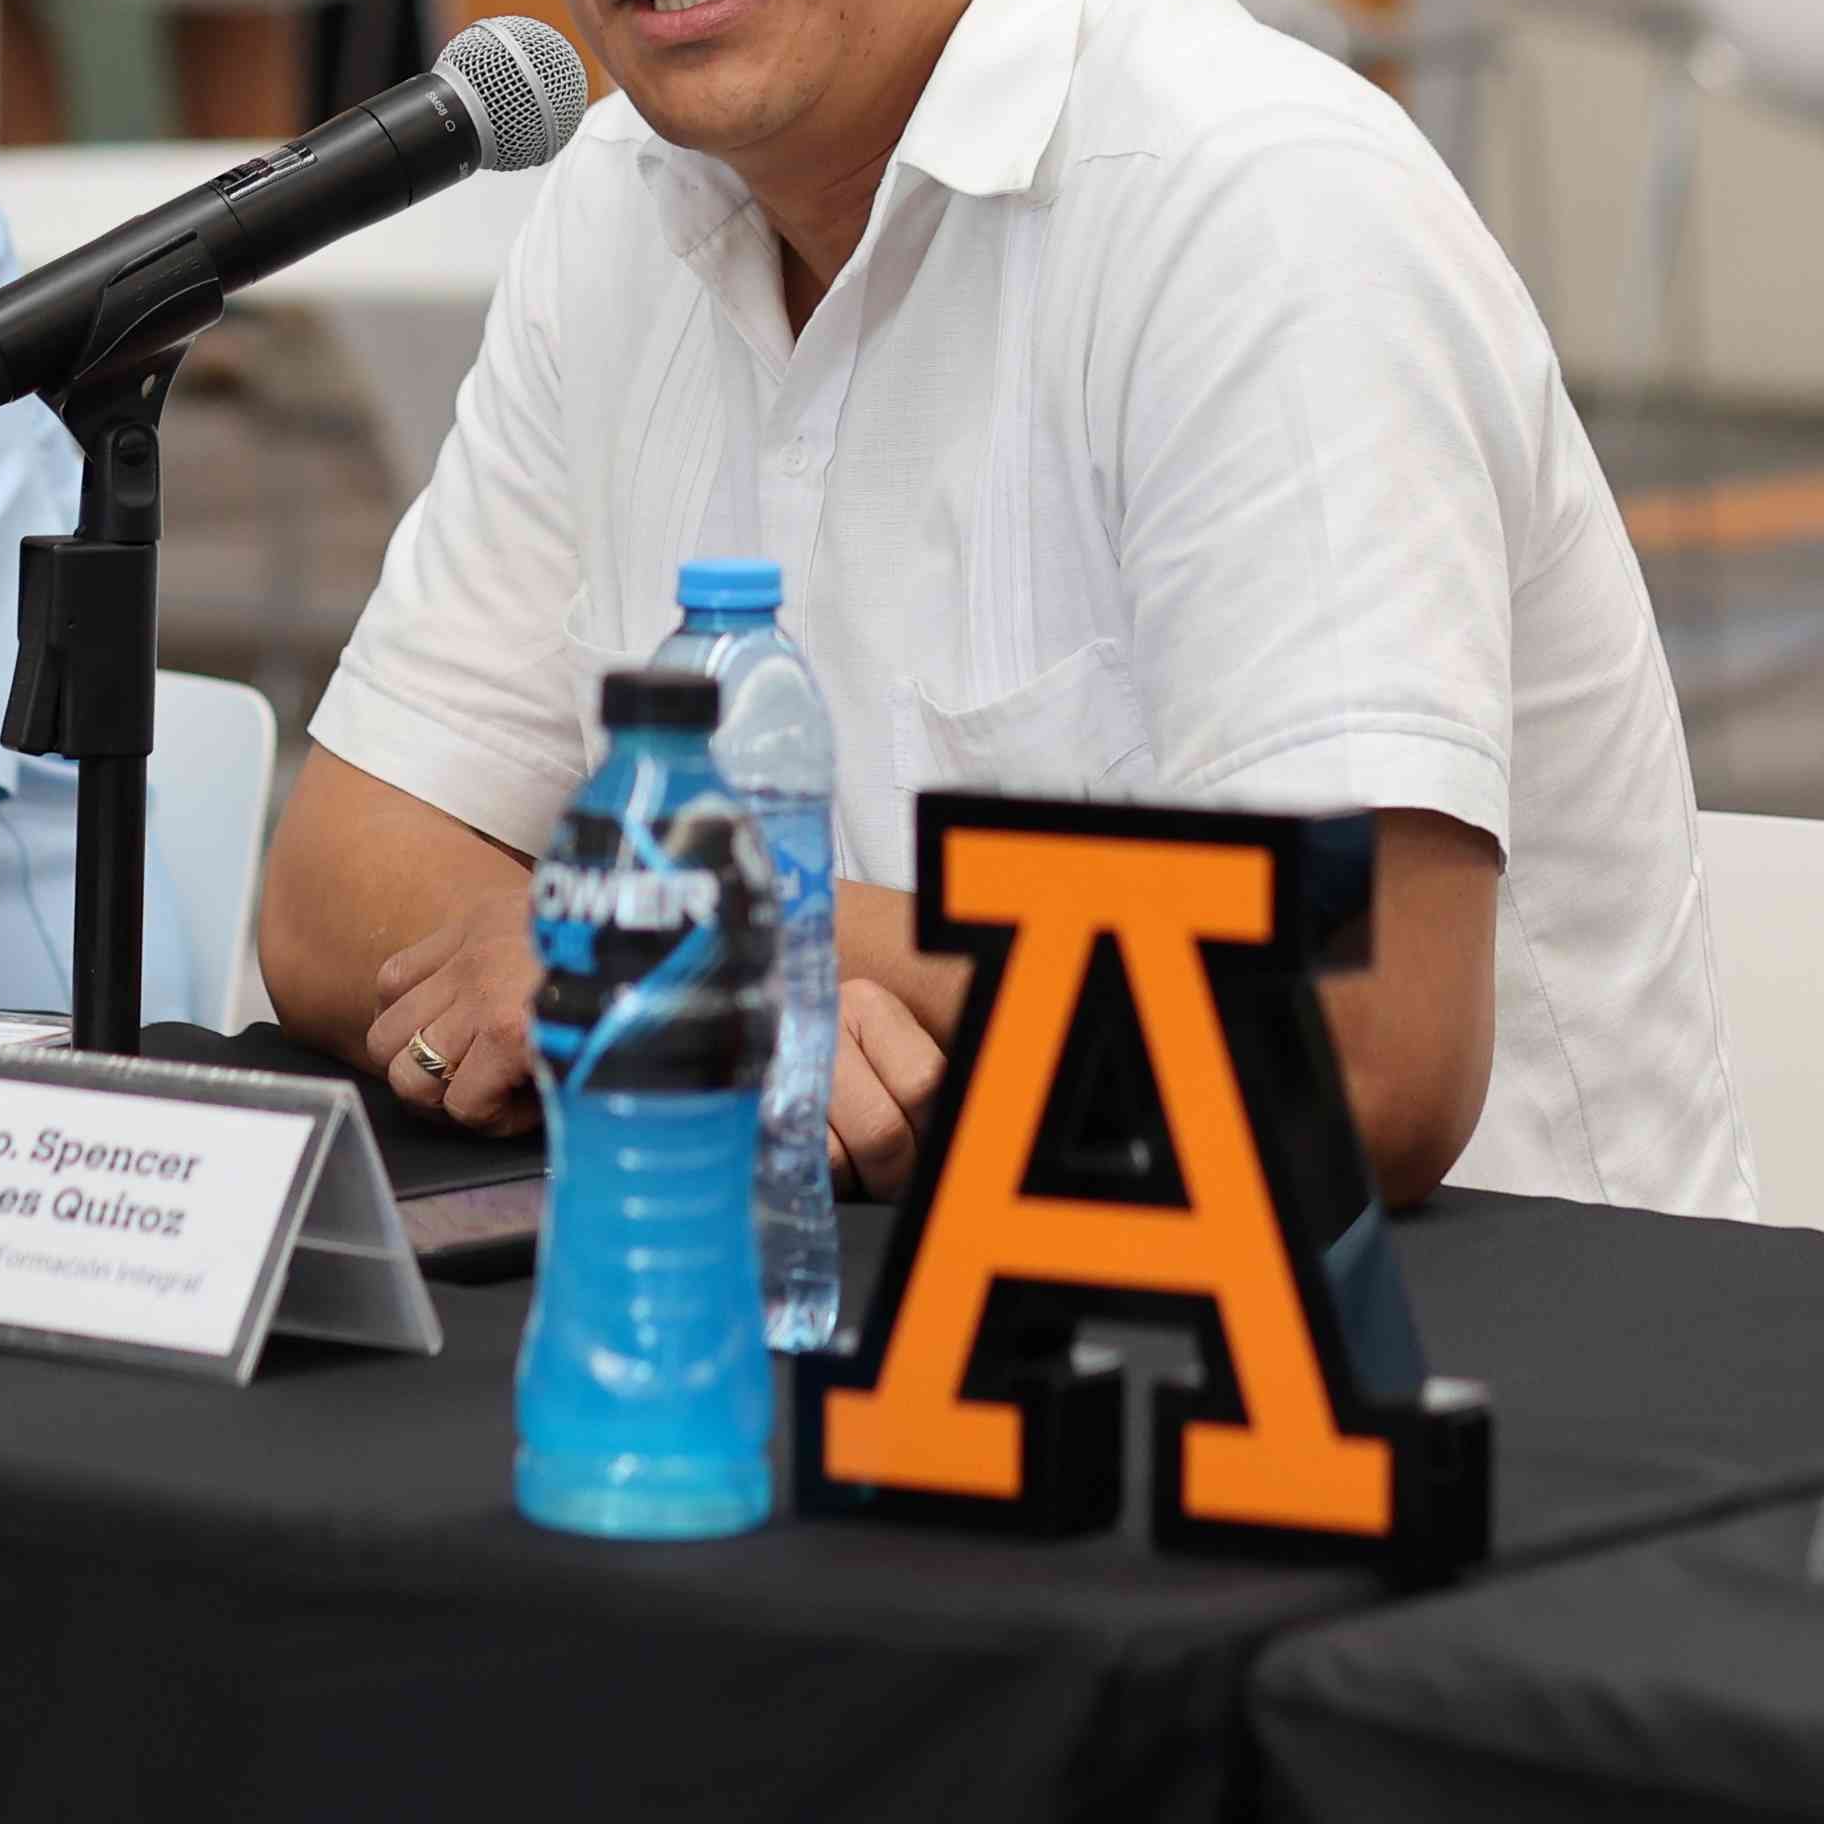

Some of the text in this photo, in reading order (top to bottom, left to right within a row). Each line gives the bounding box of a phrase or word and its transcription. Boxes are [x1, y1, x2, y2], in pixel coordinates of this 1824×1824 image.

[30, 1127, 202, 1182] Spencer
[816, 818, 1398, 1542] A
[51, 1186, 188, 1237] Quiroz
